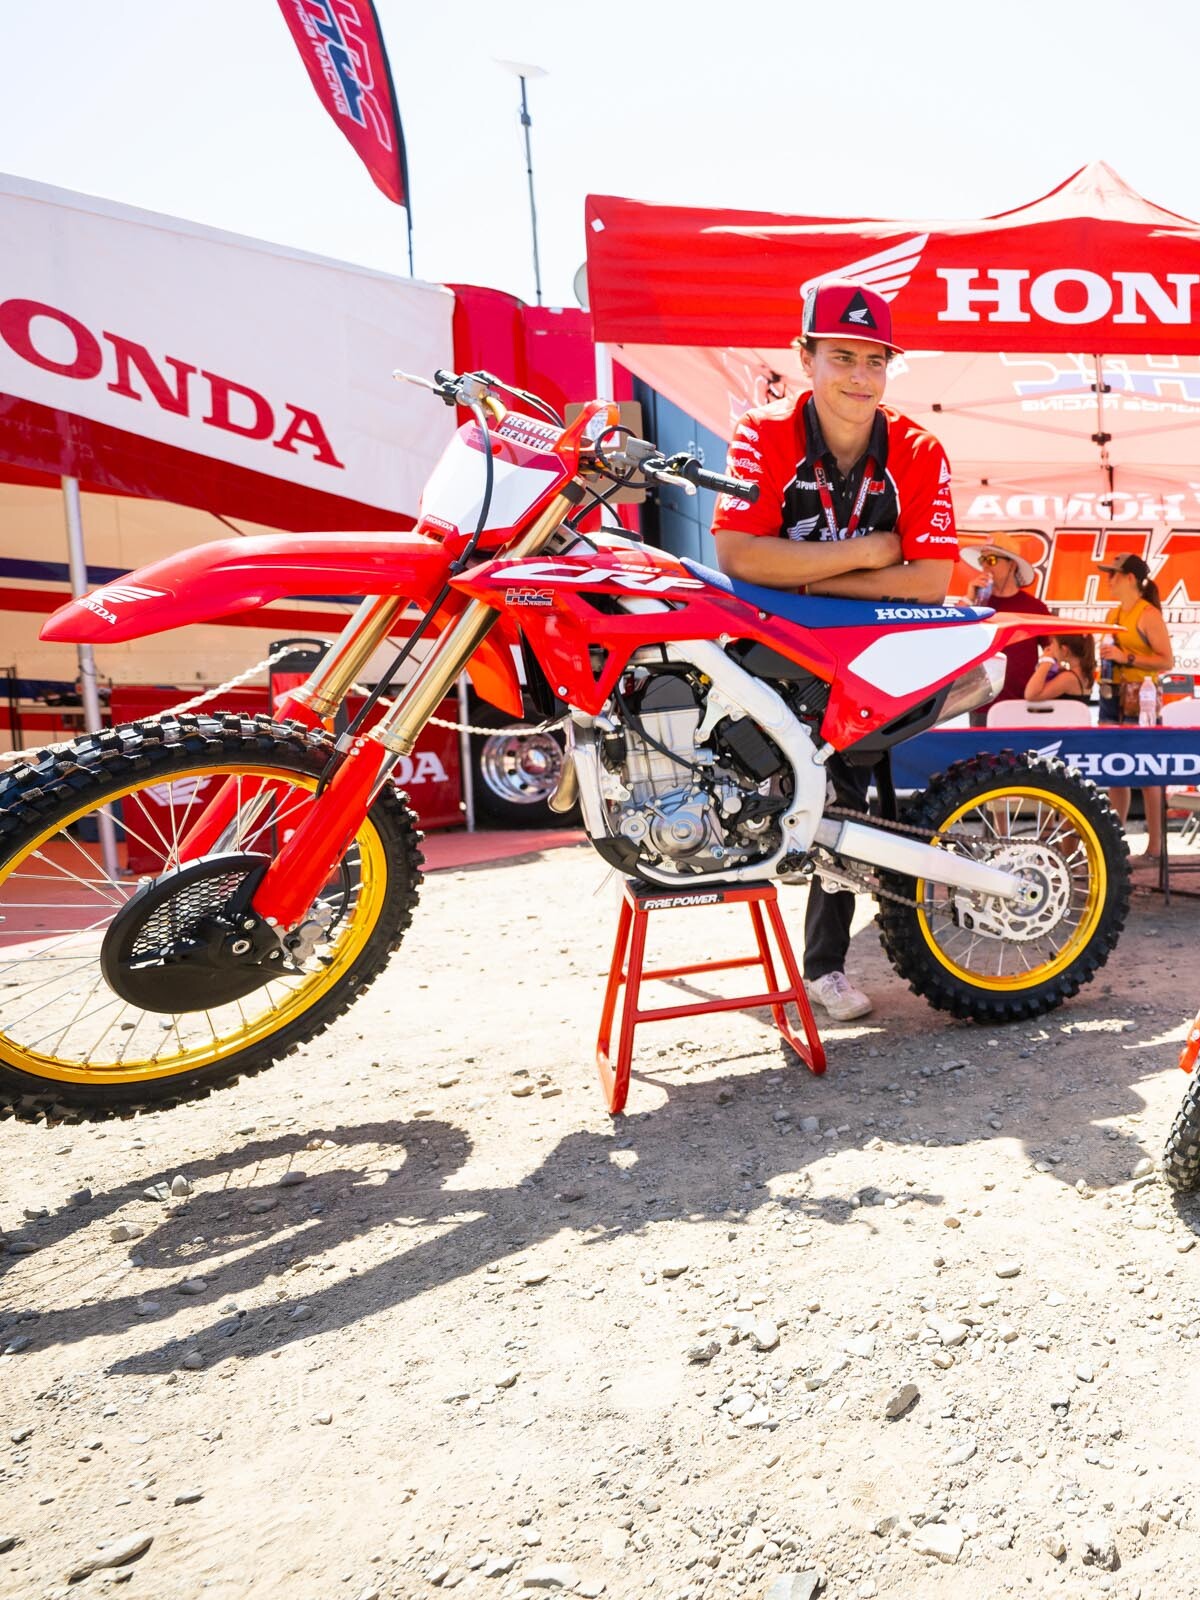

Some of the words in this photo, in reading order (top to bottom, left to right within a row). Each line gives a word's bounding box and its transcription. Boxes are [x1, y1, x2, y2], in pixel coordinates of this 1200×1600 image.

[312, 40, 351, 116] RACING
[0, 298, 346, 470] ONDA
[425, 515, 455, 533] HONDA
[490, 562, 706, 593] CRF
[505, 588, 555, 603] HRC
[874, 607, 965, 621] HONDA
[672, 893, 718, 908] POWER
